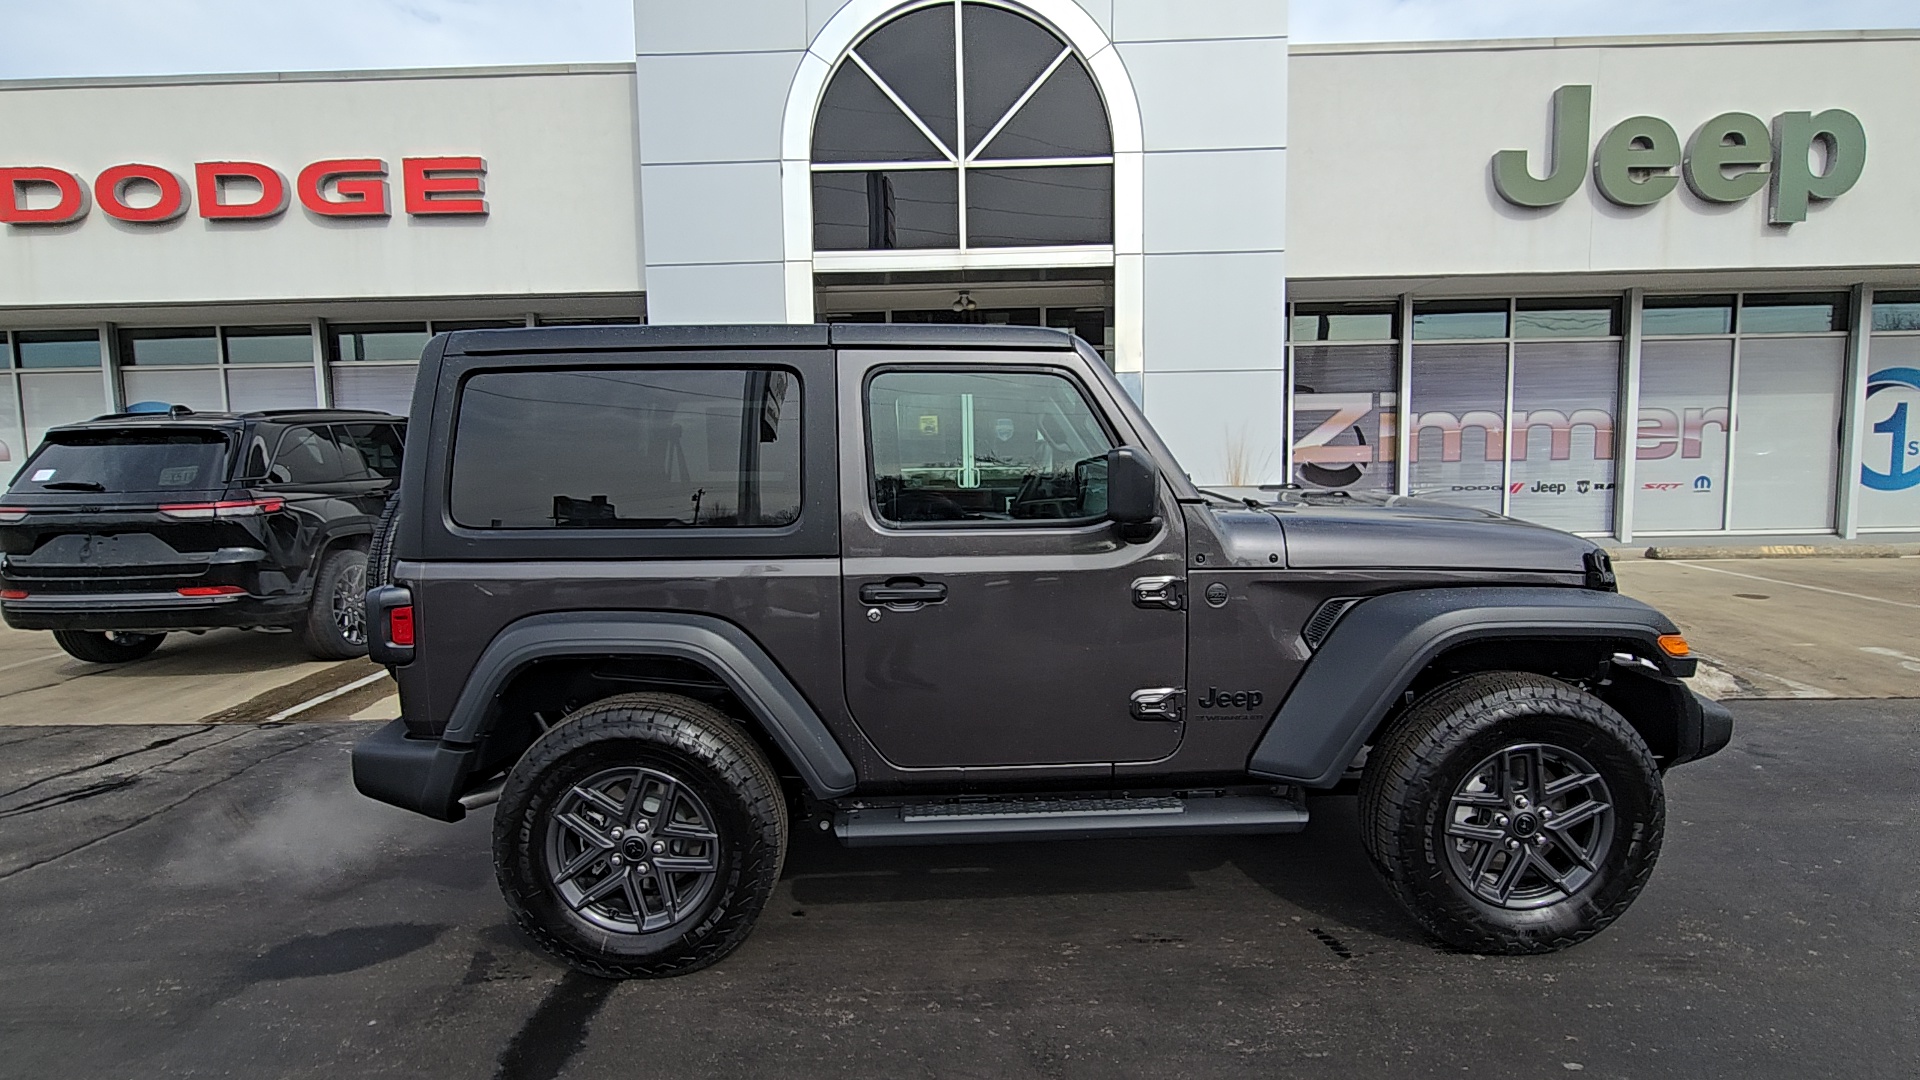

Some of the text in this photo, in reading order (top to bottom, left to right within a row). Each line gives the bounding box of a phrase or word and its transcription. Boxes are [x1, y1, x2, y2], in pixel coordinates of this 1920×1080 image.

[1492, 84, 1867, 224] Jeep
[0, 156, 489, 224] DODGE
[1293, 391, 1738, 464] Zimmer
[1530, 480, 1566, 495] Jeep
[1593, 482, 1615, 491] RA
[1641, 482, 1685, 492] SRT
[1760, 545, 1817, 554] VISITOR
[1198, 686, 1263, 711] Jeep
